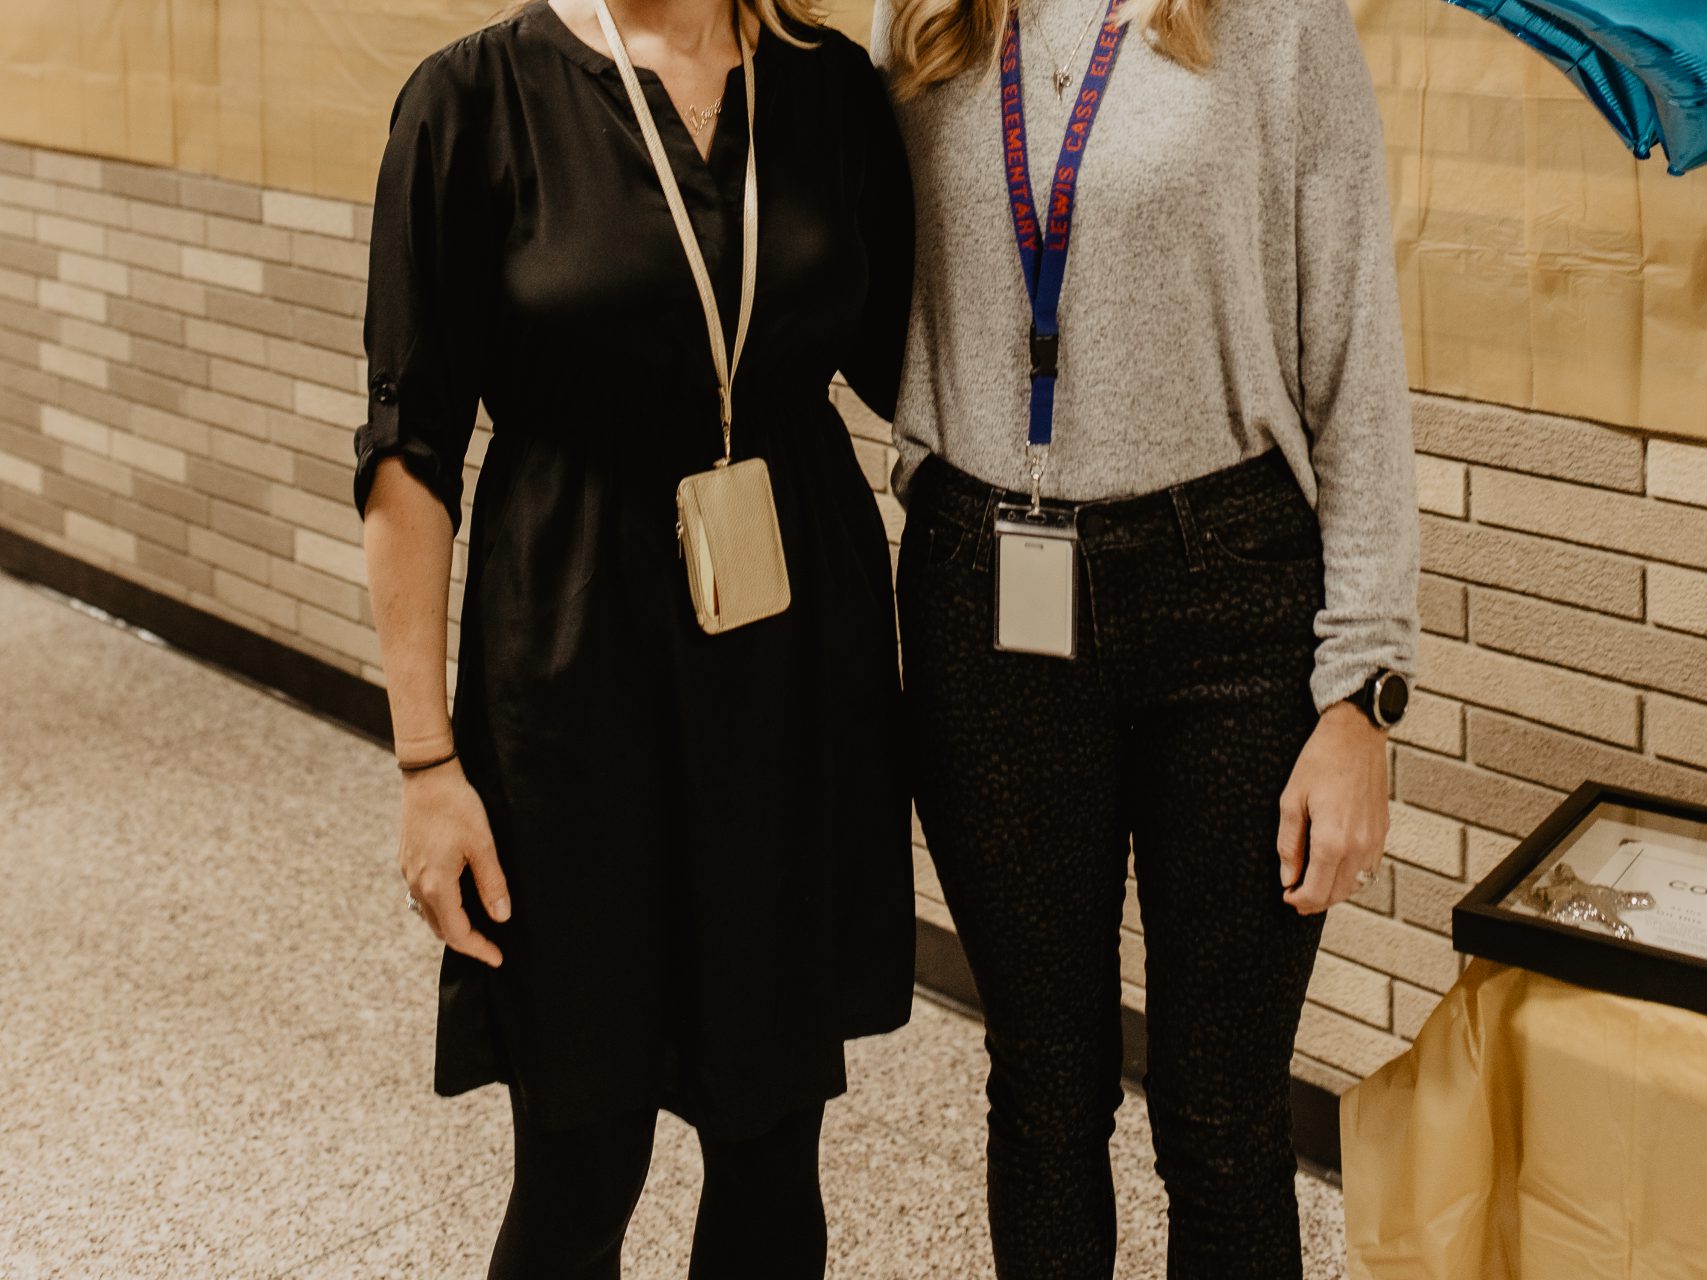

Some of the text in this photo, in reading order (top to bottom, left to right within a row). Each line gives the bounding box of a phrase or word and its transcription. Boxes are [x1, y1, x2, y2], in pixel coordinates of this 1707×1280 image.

[1003, 83, 1037, 251] ELEMENTARY
[1048, 166, 1074, 251] LEWIS
[1065, 88, 1098, 153] CASS
